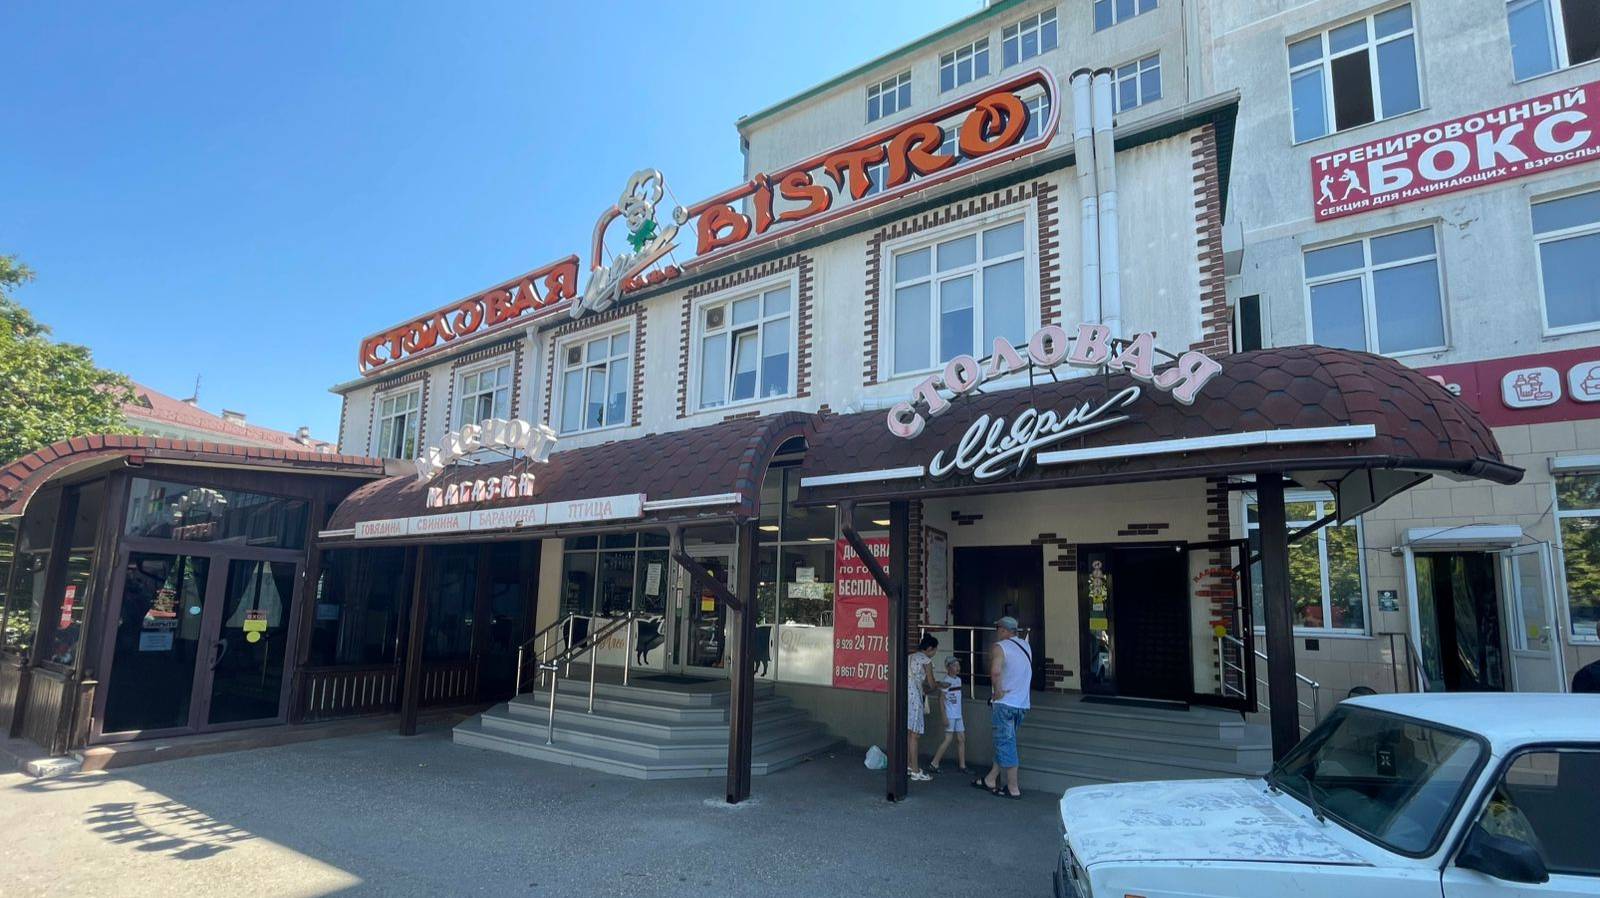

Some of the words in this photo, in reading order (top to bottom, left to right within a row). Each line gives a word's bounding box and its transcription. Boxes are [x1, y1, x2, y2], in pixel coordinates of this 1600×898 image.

[1316, 87, 1586, 171] ТРЕНИРОВОЧНЫЙ
[1367, 110, 1592, 196] БОКС
[1320, 199, 1370, 216] СЕКЦИЯ
[1372, 193, 1400, 206] ДЛЯ
[1402, 167, 1507, 198] НАЧИНАЮЩИХ
[365, 262, 580, 366] СТОЛОВАЯ
[887, 323, 1223, 439] СТОЛОВАЯ
[426, 472, 536, 509] МАГАЗИН
[417, 516, 459, 530] СВИНИНА
[479, 508, 536, 526] БАРАНИНА
[567, 501, 613, 519] ПТИЦА
[867, 635, 884, 651] 777
[858, 663, 876, 679] 677
